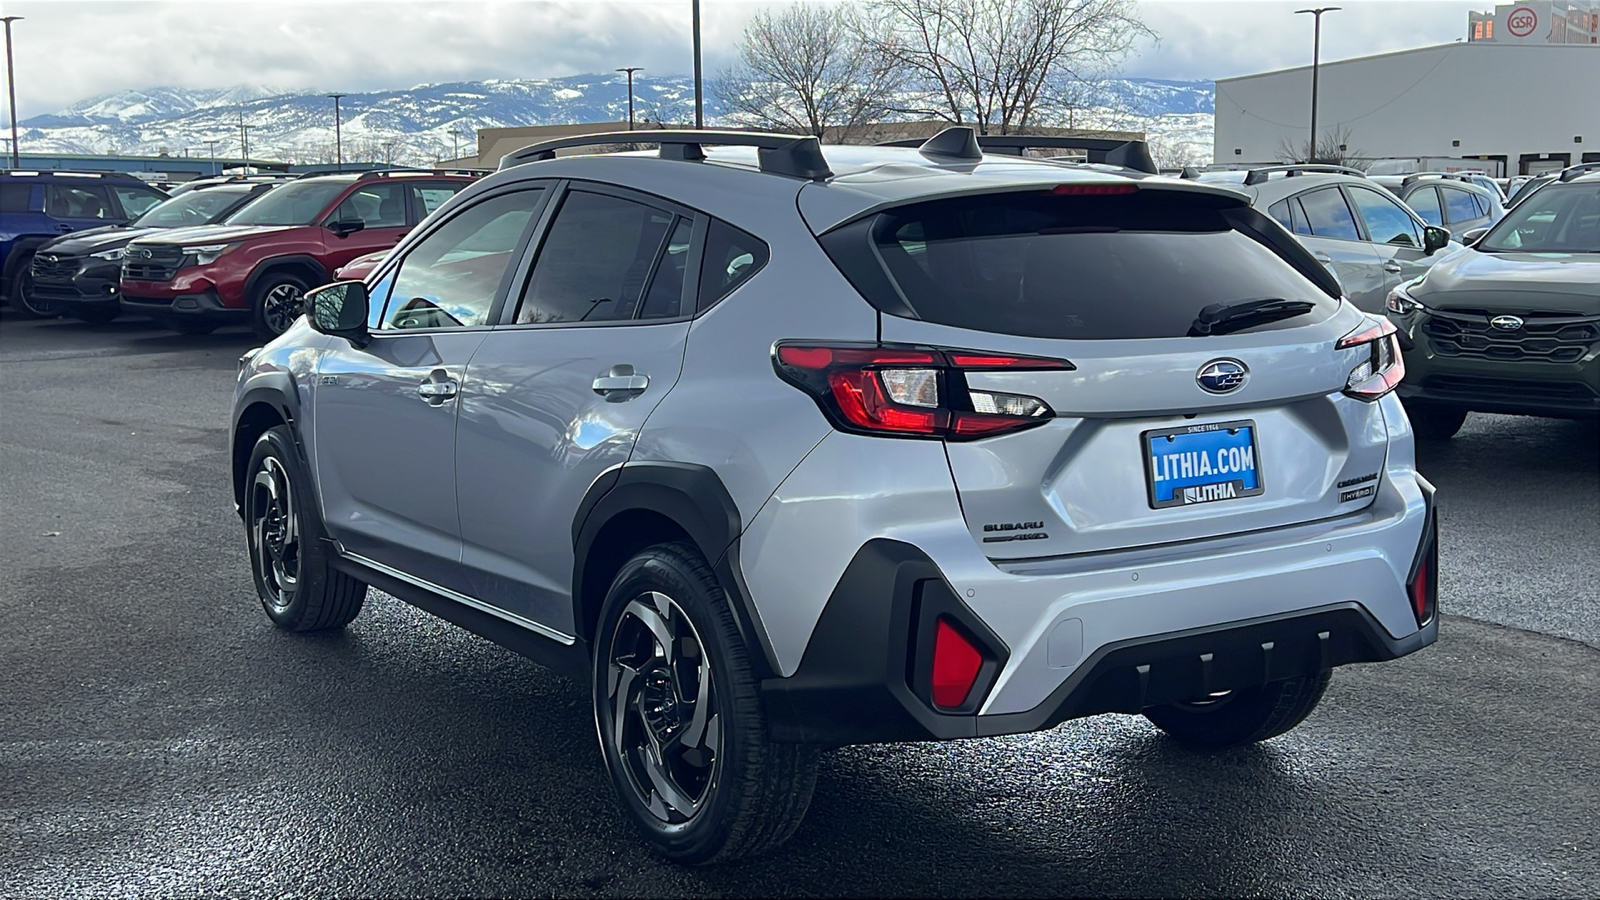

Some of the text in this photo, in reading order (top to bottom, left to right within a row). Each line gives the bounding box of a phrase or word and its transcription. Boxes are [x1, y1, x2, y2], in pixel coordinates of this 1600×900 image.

[1511, 16, 1533, 28] GSR
[1187, 425, 1205, 434] SINCE
[1152, 445, 1255, 482] LITHIA.COM
[1196, 482, 1237, 502] LITHIA
[983, 521, 1044, 532] SUBARU
[1009, 532, 1049, 541] AWD
